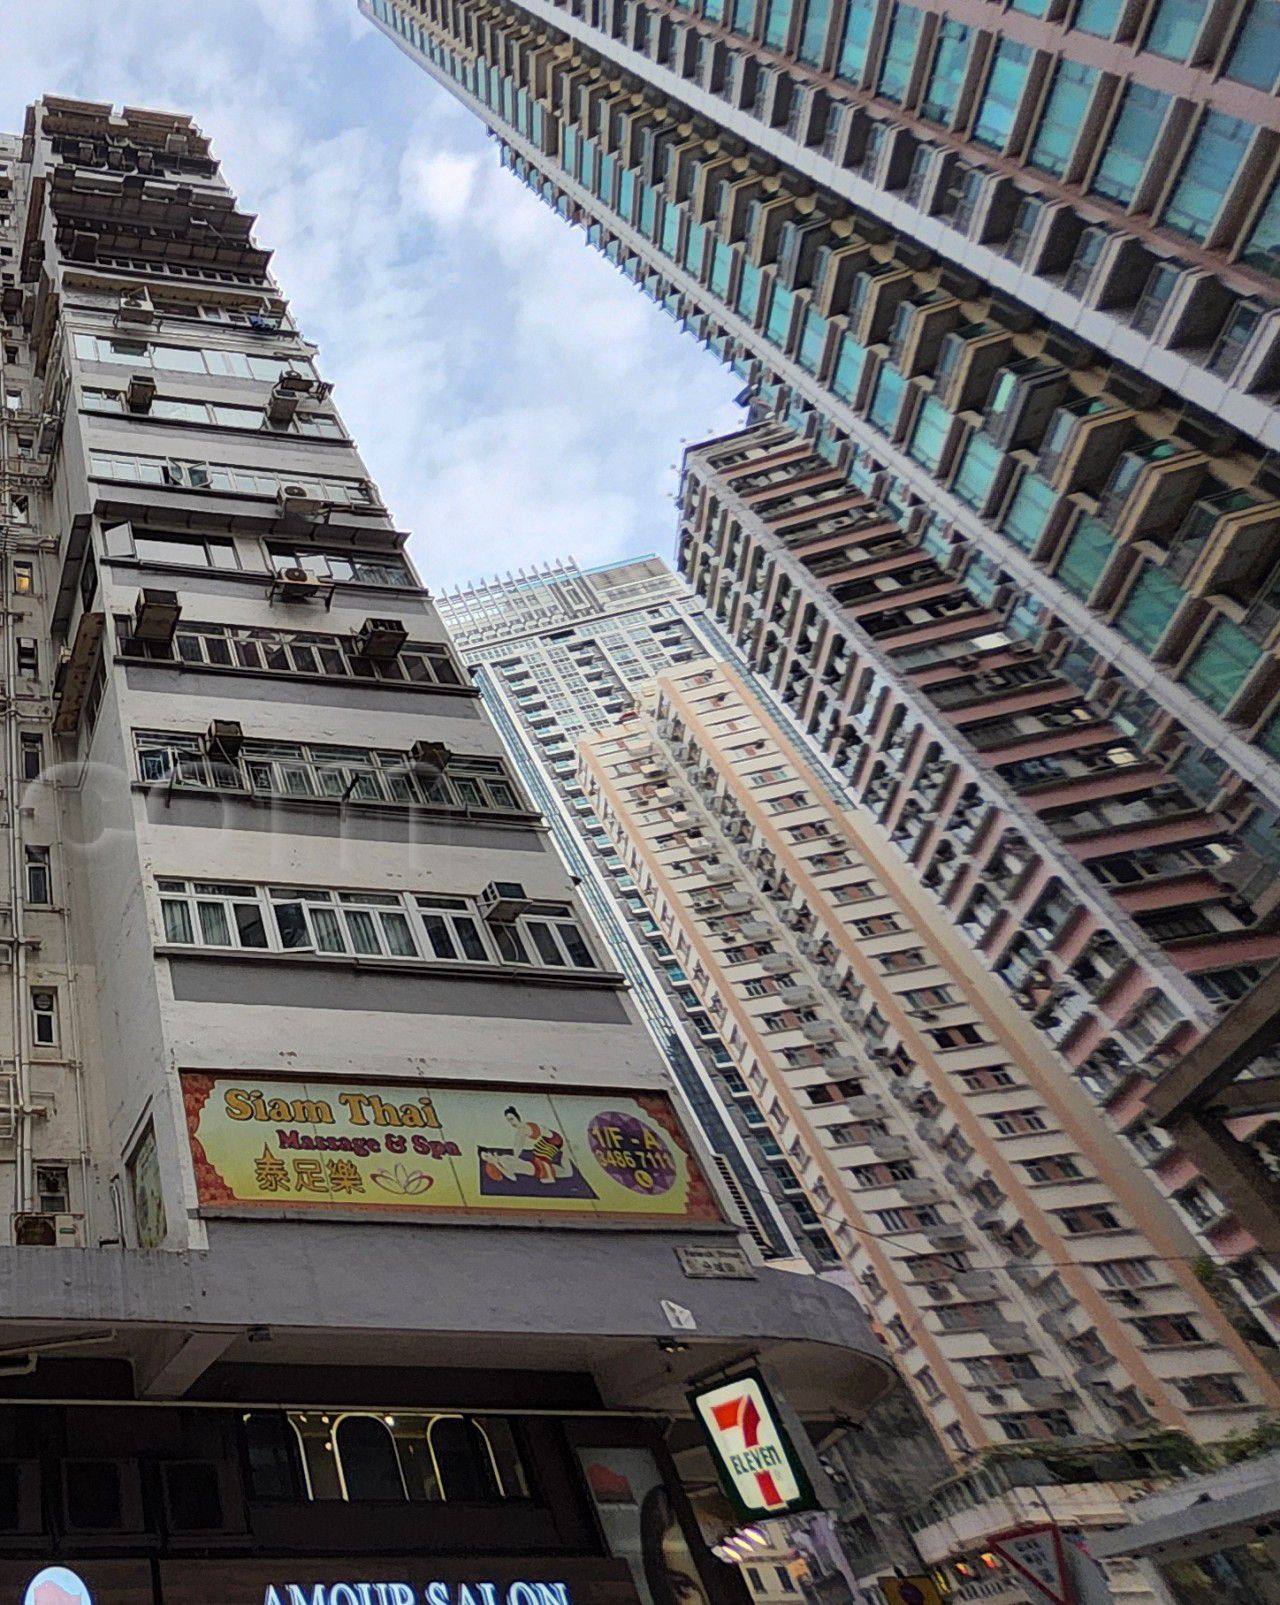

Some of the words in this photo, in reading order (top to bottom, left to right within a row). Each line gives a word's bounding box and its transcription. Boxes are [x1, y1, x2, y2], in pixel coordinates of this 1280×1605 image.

[224, 1088, 336, 1124] Siam
[339, 1093, 443, 1129] Thai
[276, 1129, 382, 1158] Massage
[385, 1133, 408, 1154] &
[412, 1134, 463, 1160] Spa
[592, 1126, 624, 1149] 1/F
[254, 1142, 366, 1195] 泰足樂
